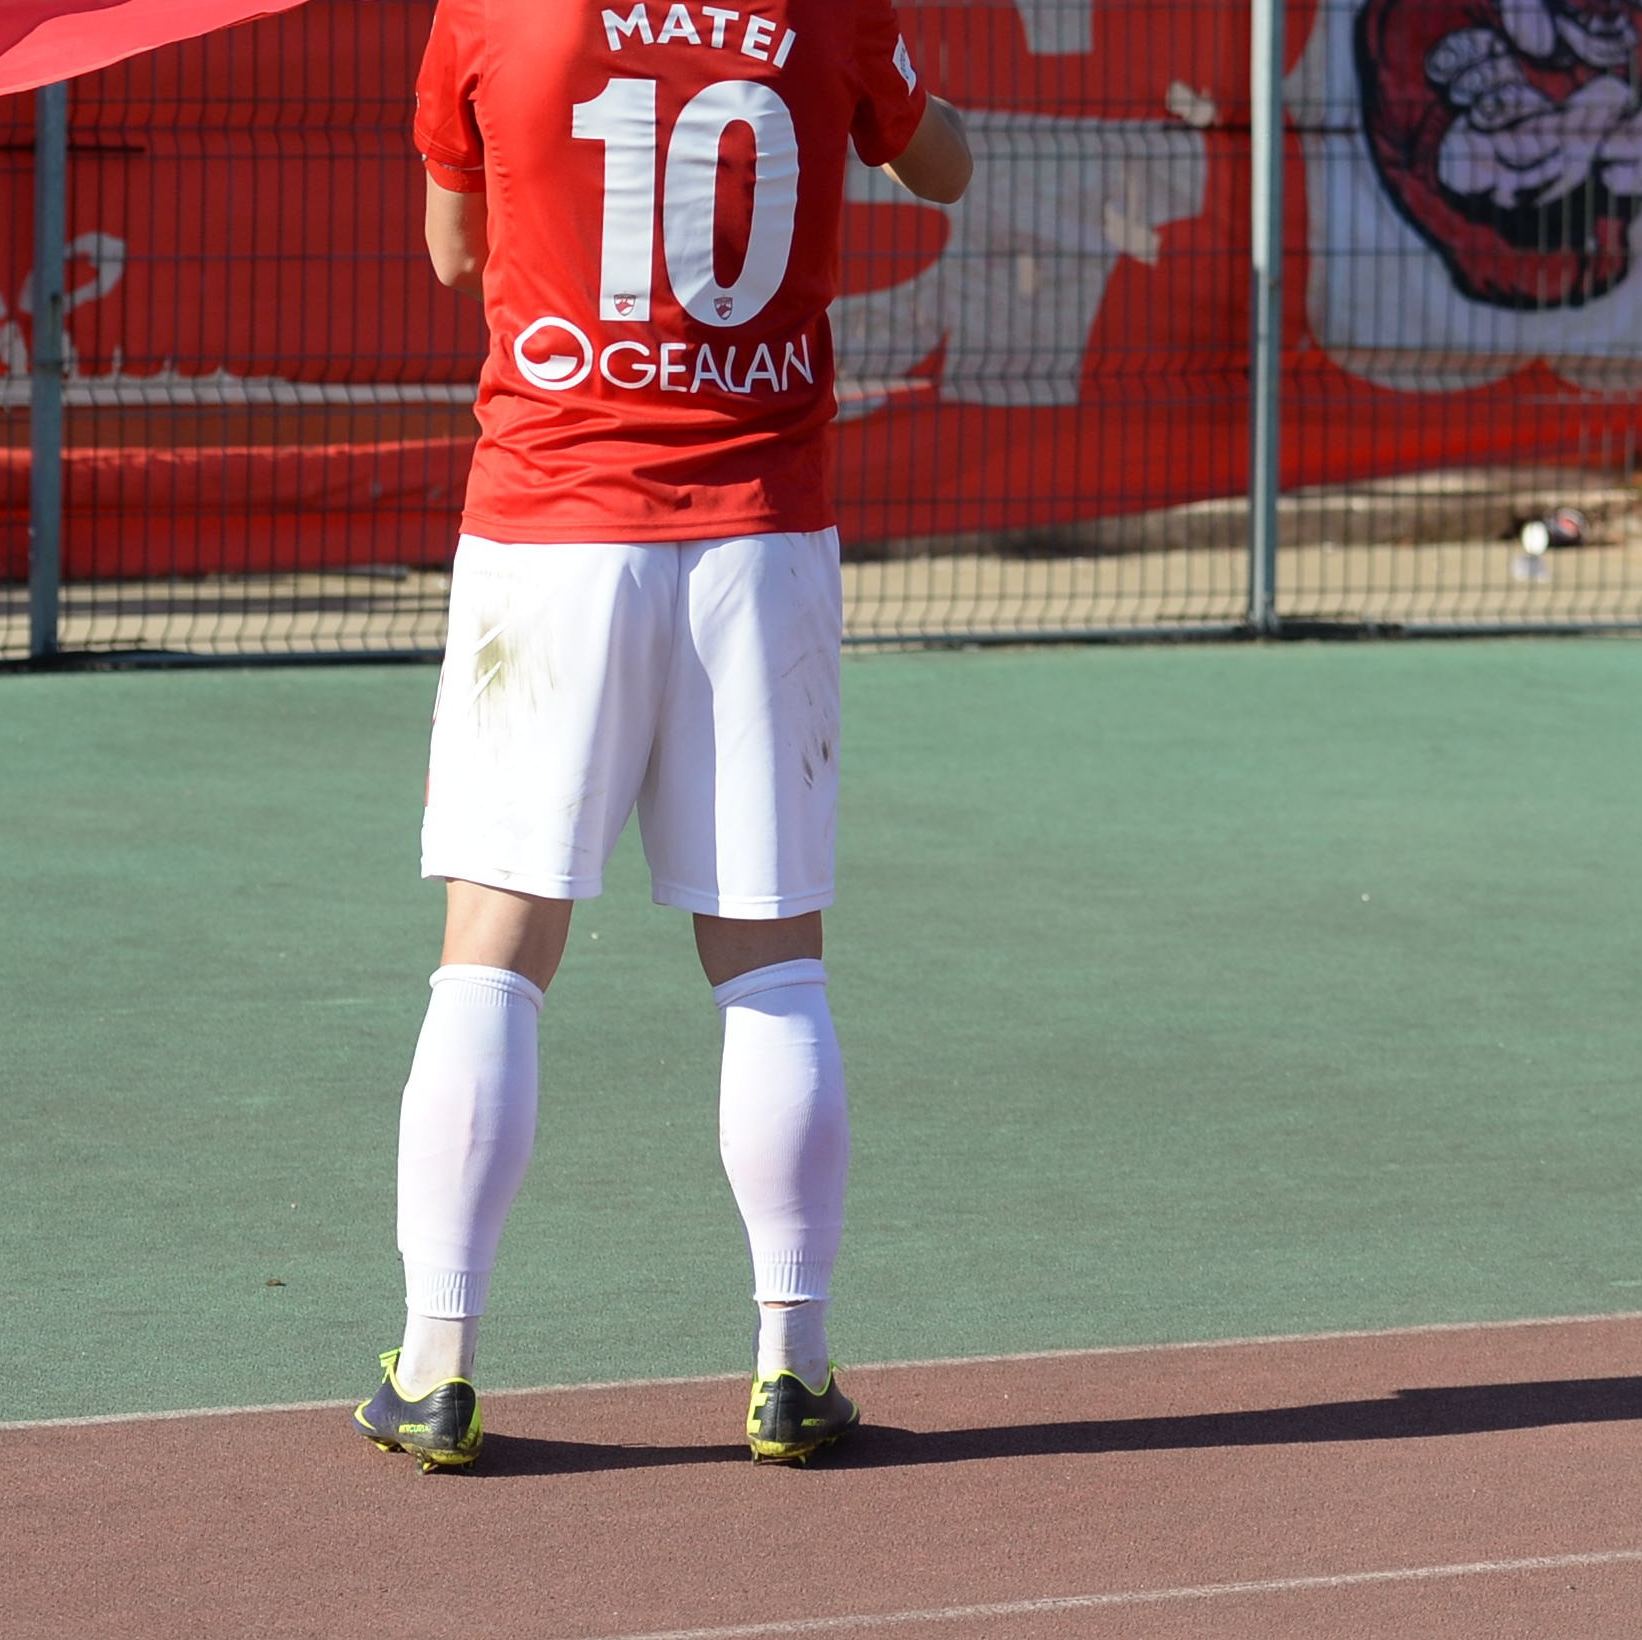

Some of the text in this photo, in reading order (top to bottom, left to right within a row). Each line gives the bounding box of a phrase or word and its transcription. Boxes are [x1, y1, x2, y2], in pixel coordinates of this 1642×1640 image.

[600, 2, 797, 69] MATEI
[571, 77, 800, 328] 10
[599, 334, 814, 395] GEALAN
